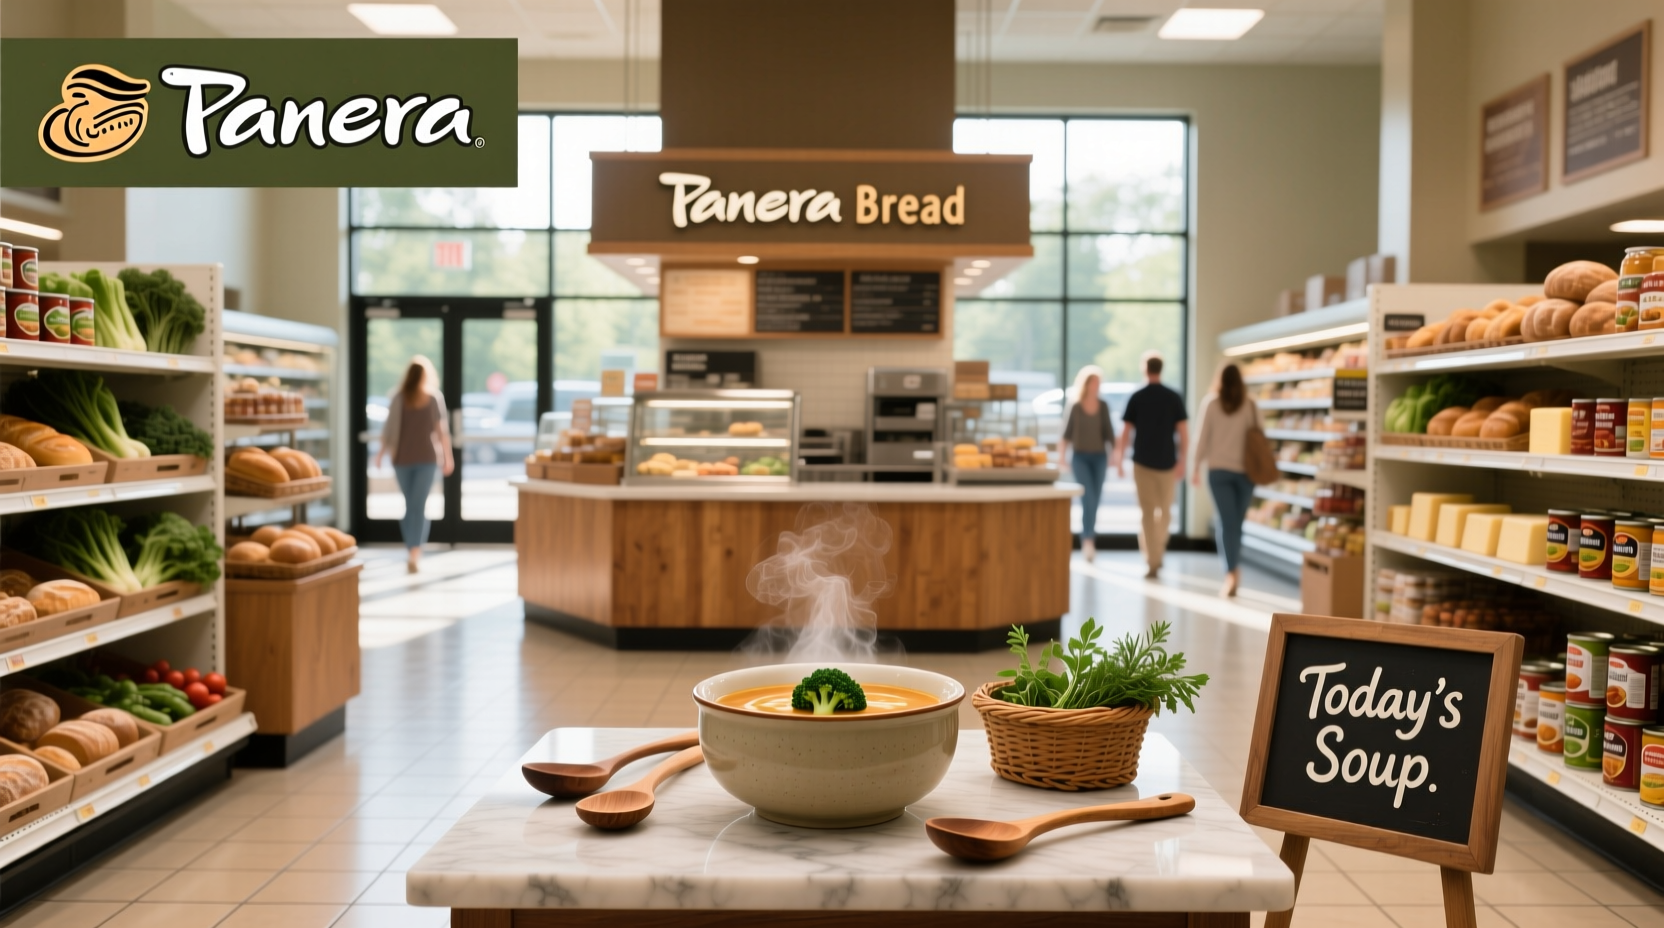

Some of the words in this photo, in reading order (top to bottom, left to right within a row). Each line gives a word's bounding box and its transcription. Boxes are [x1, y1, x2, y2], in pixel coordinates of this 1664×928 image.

[658, 172, 842, 228] Panera
[856, 184, 965, 225] Bread
[1299, 662, 1464, 741] Today's
[1305, 724, 1438, 809] Soup.
